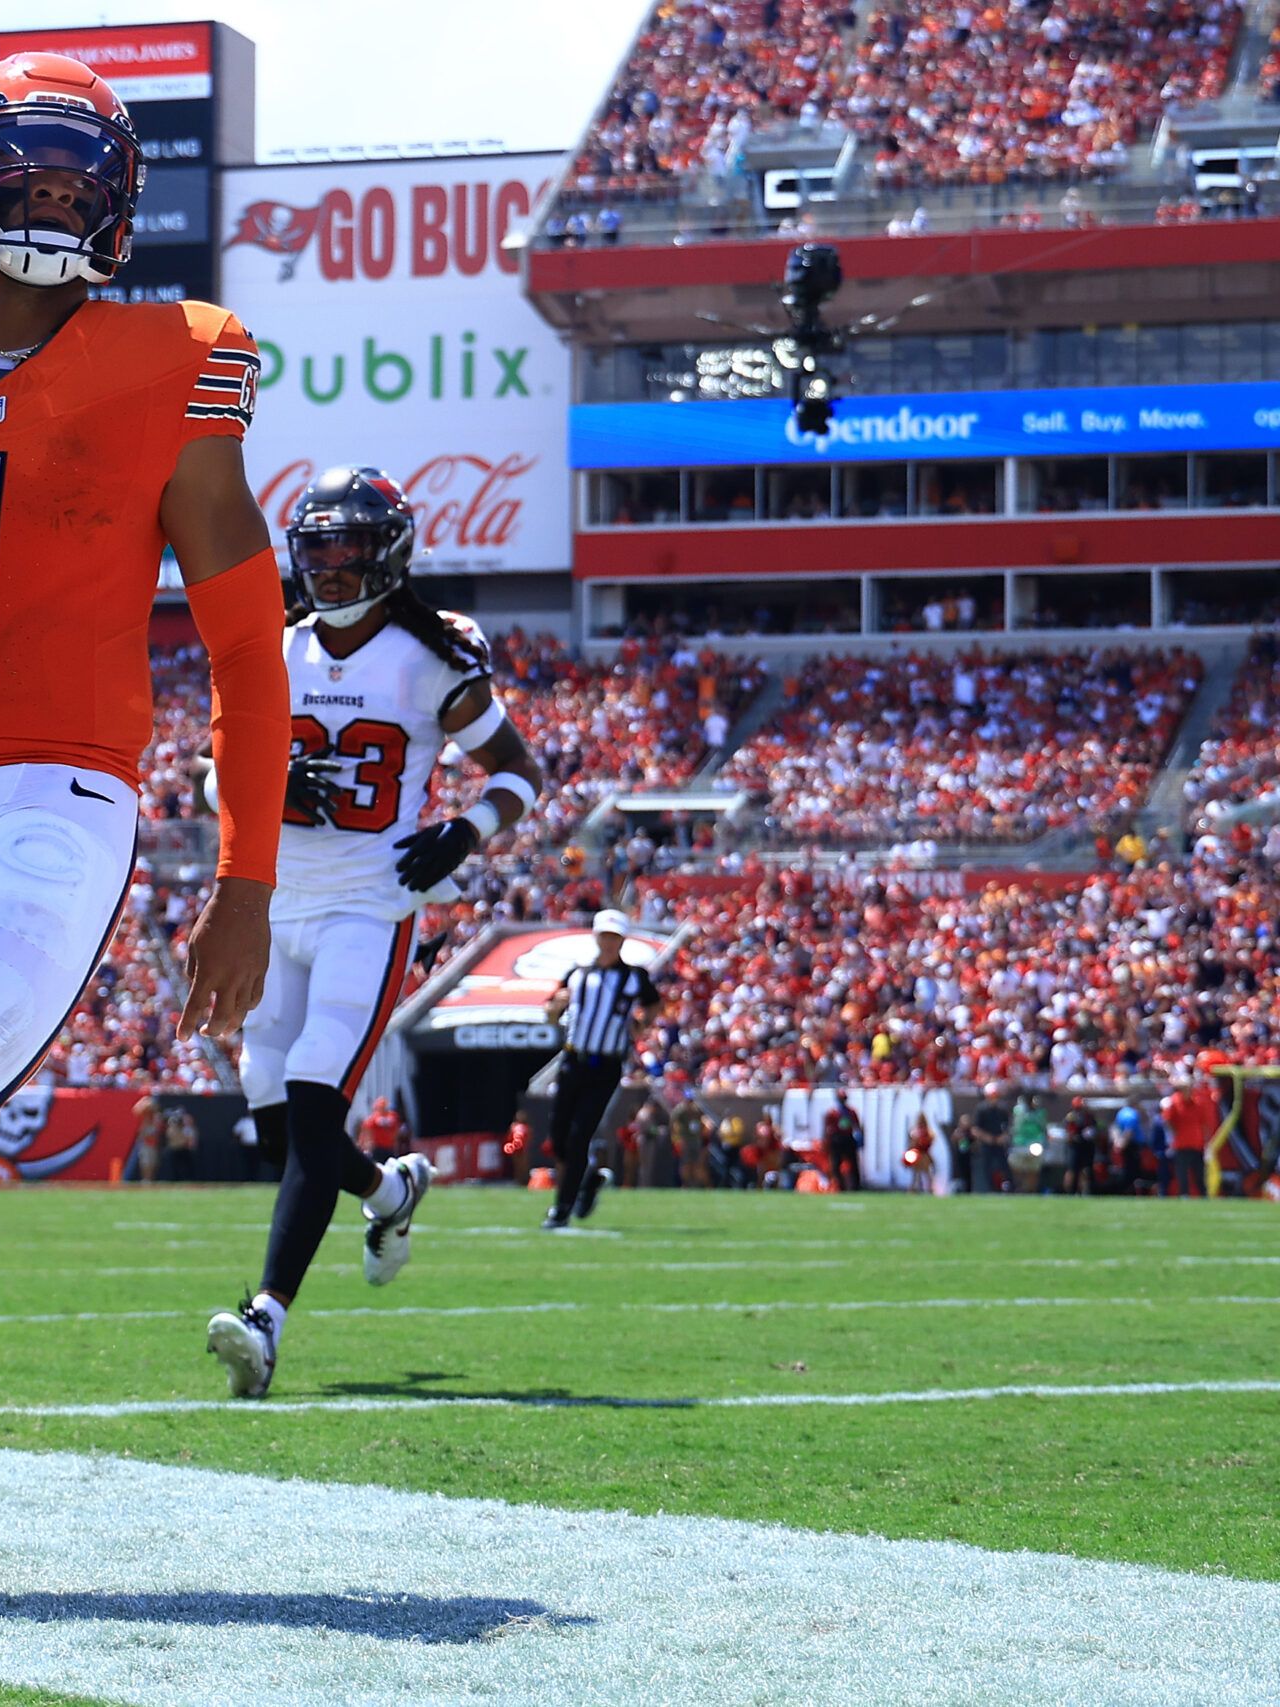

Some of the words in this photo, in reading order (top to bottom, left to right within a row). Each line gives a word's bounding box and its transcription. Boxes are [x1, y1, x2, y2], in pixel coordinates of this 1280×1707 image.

[320, 185, 396, 281] GO
[410, 179, 552, 278] BUC
[1022, 412, 1069, 434] Sell.
[1081, 409, 1127, 434] Buy.
[1138, 408, 1206, 431] Move.
[302, 693, 364, 709] BUCCANEERS
[453, 1024, 558, 1048] GEICO
